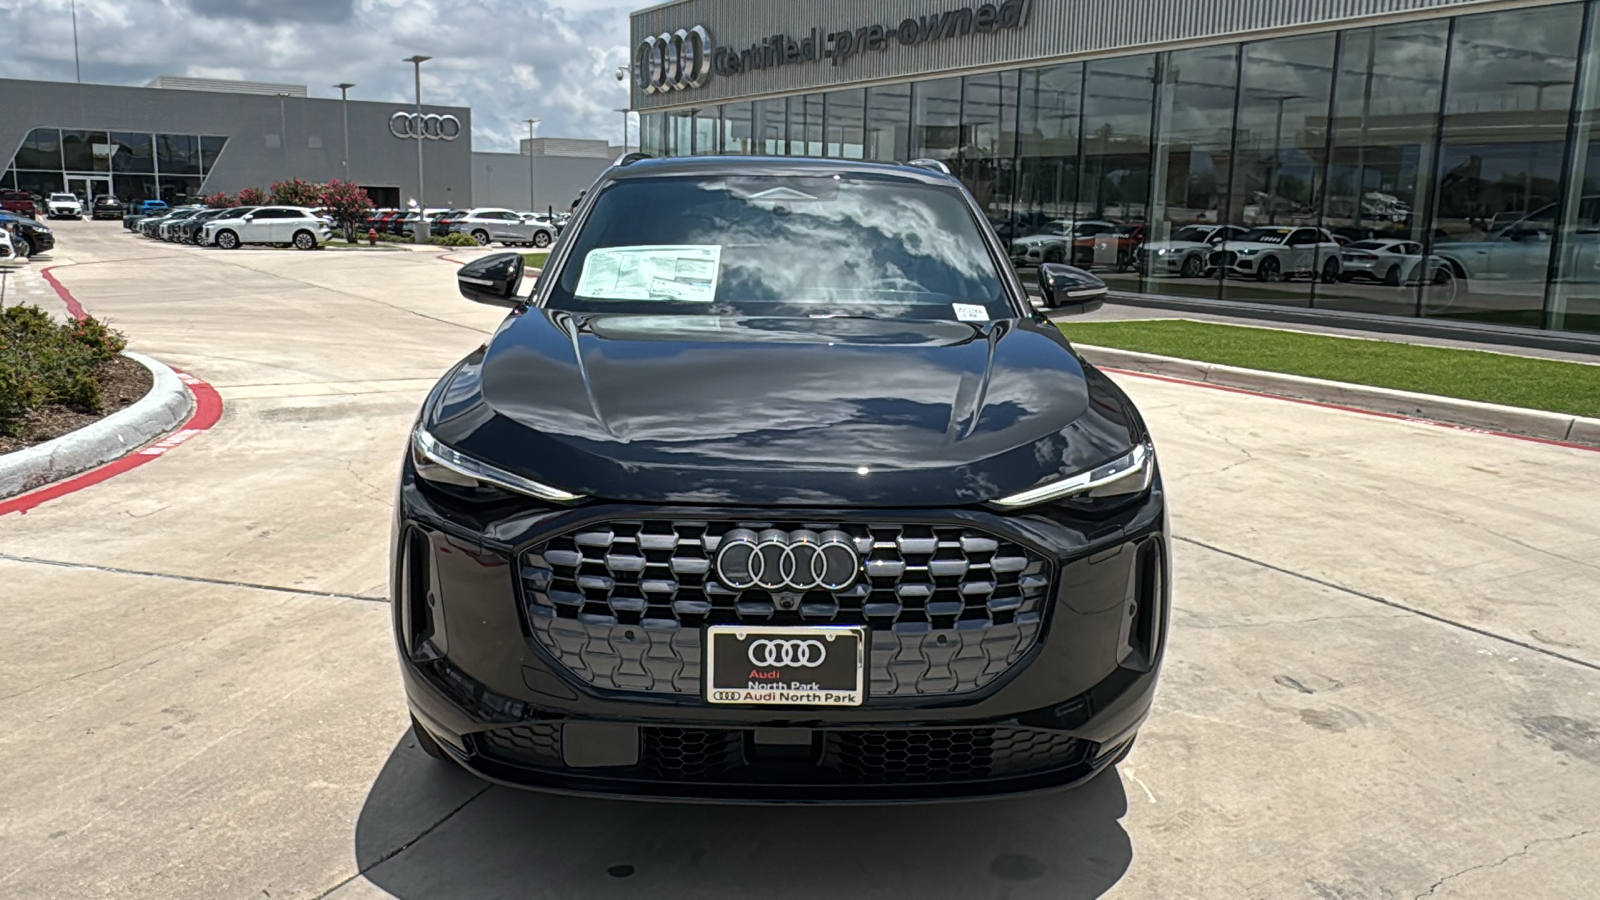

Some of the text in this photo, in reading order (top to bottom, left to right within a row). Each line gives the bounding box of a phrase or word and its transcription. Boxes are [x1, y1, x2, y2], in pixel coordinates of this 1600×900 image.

[713, 27, 823, 77] Certified
[749, 670, 780, 679] Audi
[748, 681, 820, 691] North Park
[743, 692, 856, 703] Audi North Park
